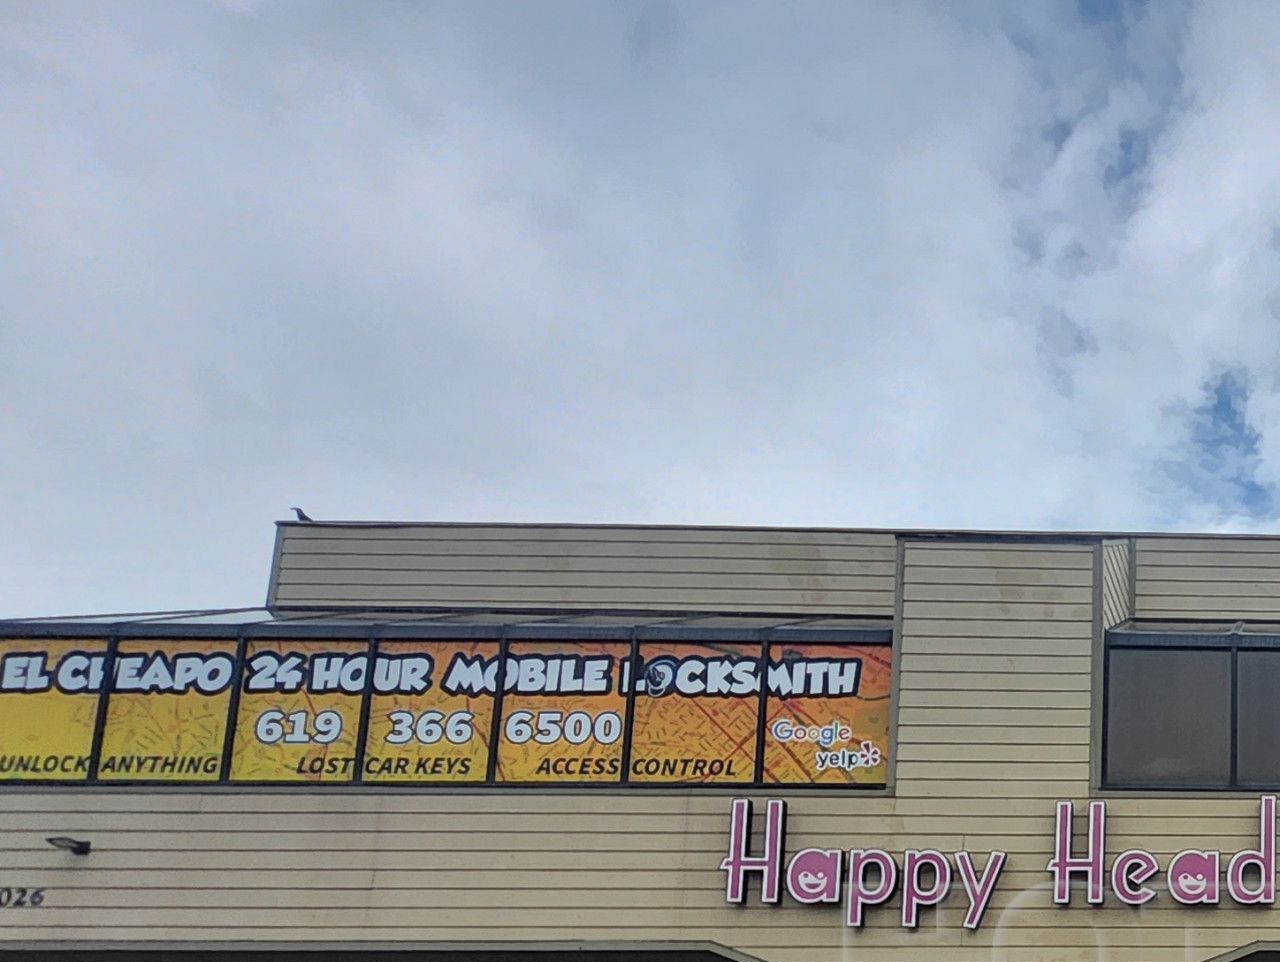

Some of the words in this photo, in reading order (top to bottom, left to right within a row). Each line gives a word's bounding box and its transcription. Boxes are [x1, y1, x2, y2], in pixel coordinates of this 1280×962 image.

[1, 654, 50, 690] EL
[248, 653, 304, 690] 24
[310, 655, 430, 693] HOUR
[444, 656, 610, 694] MOBILE
[255, 710, 342, 744] 619
[386, 710, 474, 744] 366
[504, 711, 622, 745] 6500
[773, 720, 851, 746] Google
[0, 755, 91, 772] UNLOCK
[102, 756, 219, 773] ANYTHING
[296, 756, 356, 774] LOST
[365, 757, 410, 774] CAR
[415, 757, 471, 774] KEYS
[535, 757, 619, 775] ACCESS
[632, 758, 736, 776] CONTROL
[817, 748, 859, 770] yelp
[719, 798, 1007, 928] Happy
[1046, 796, 1276, 906] Head
